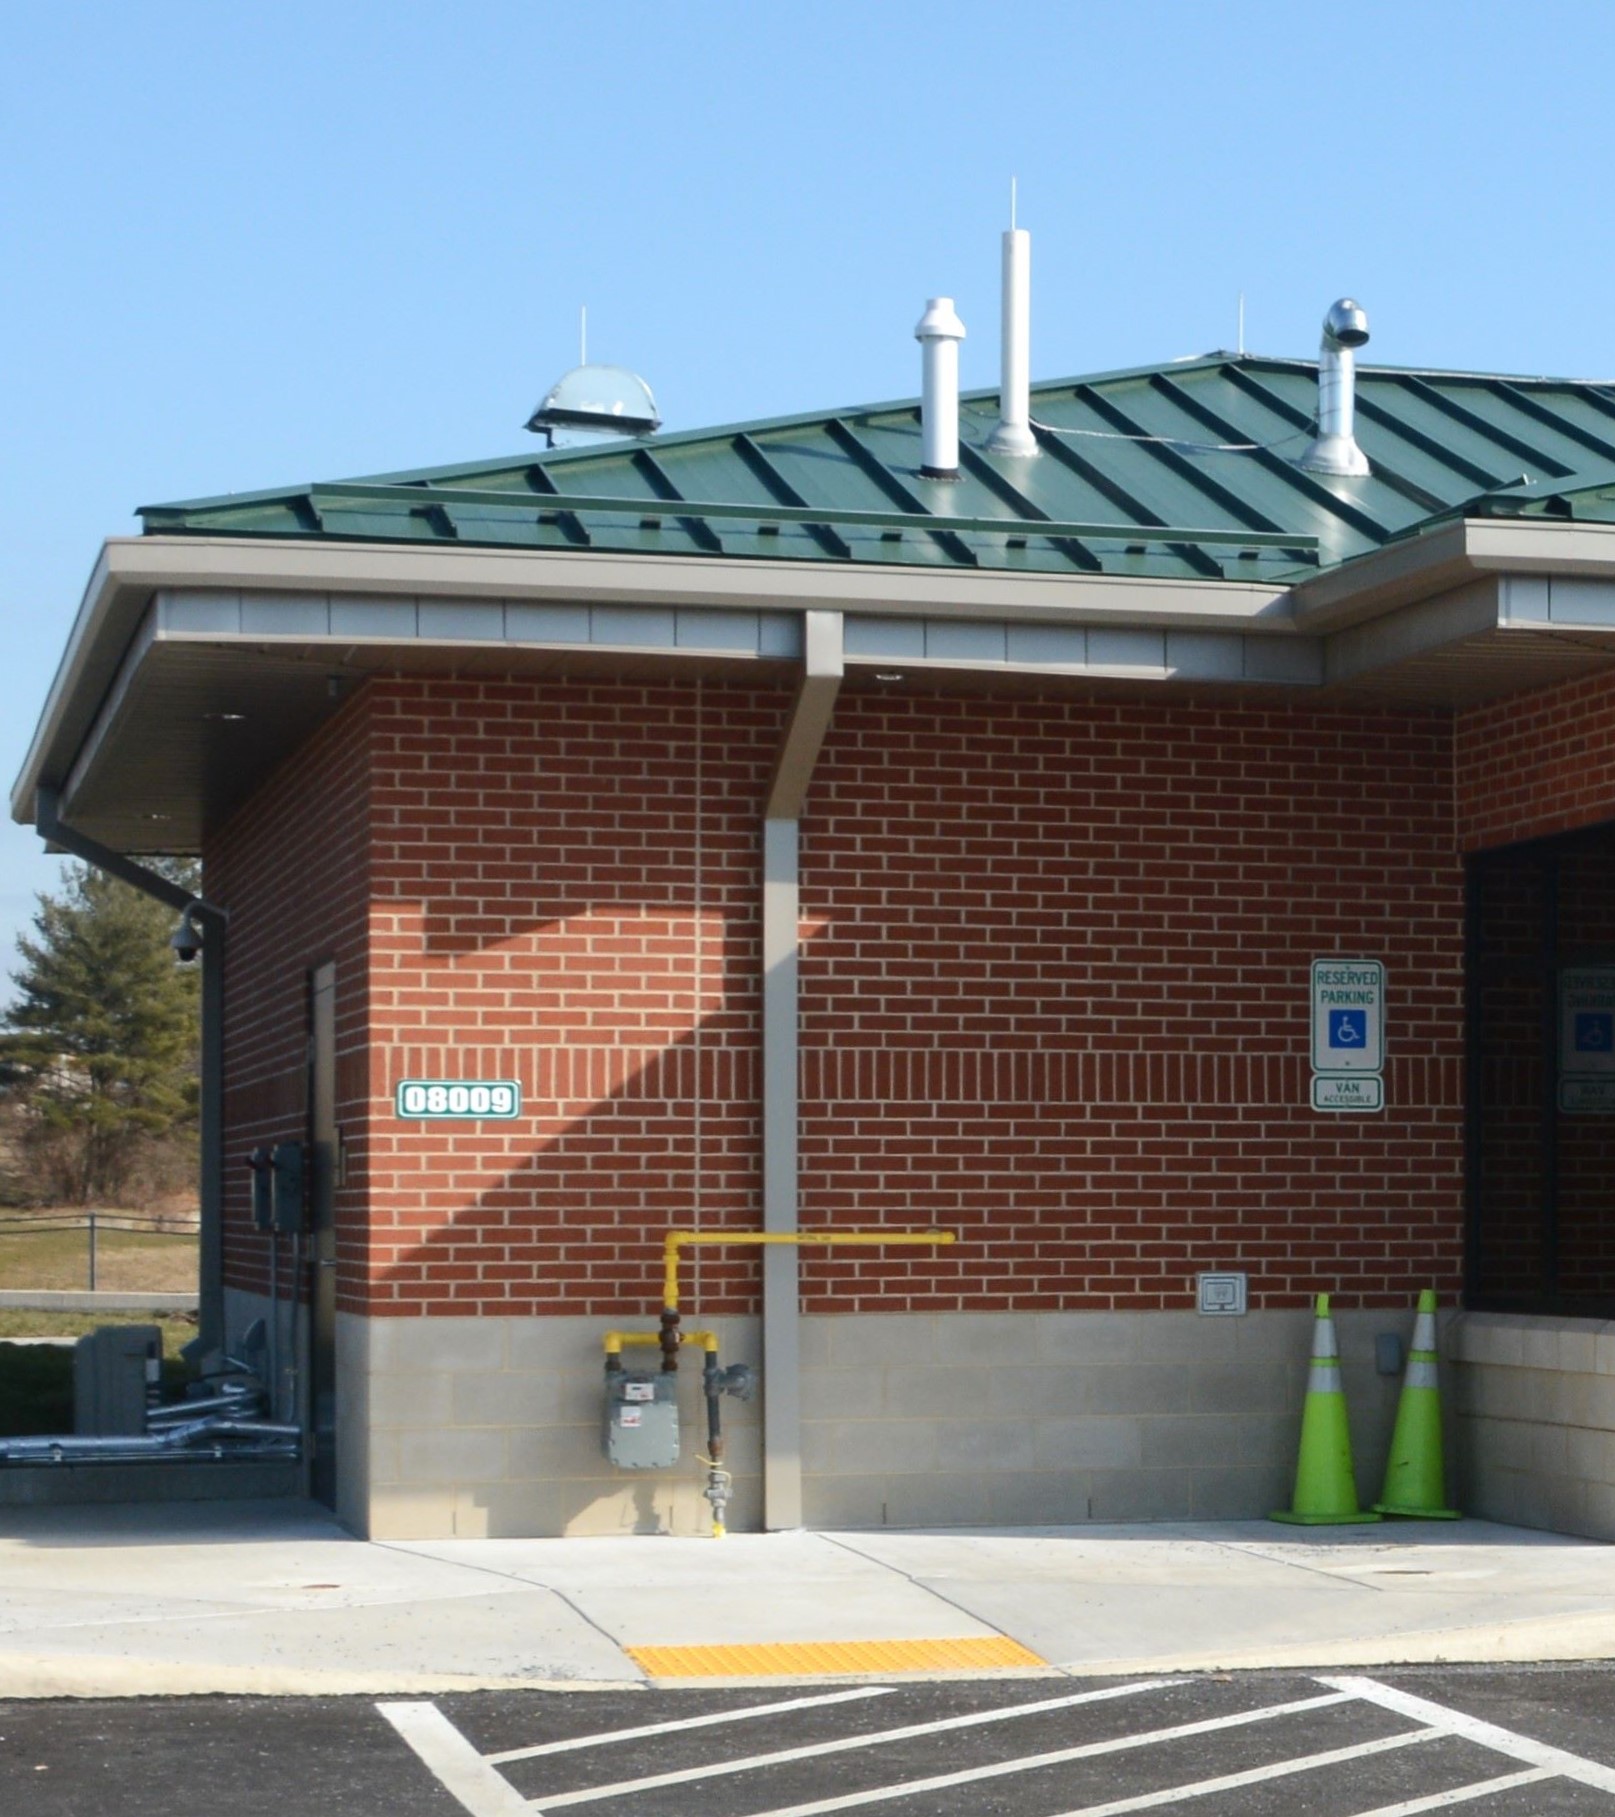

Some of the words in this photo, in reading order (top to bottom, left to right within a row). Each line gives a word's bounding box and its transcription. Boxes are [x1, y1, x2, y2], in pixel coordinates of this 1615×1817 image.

[1317, 970, 1378, 986] RESERVED
[1321, 990, 1375, 1005] PARKING
[1336, 1082, 1360, 1094] VAN
[404, 1086, 513, 1113] 08009
[1324, 1095, 1371, 1103] ACCESSIBLE
